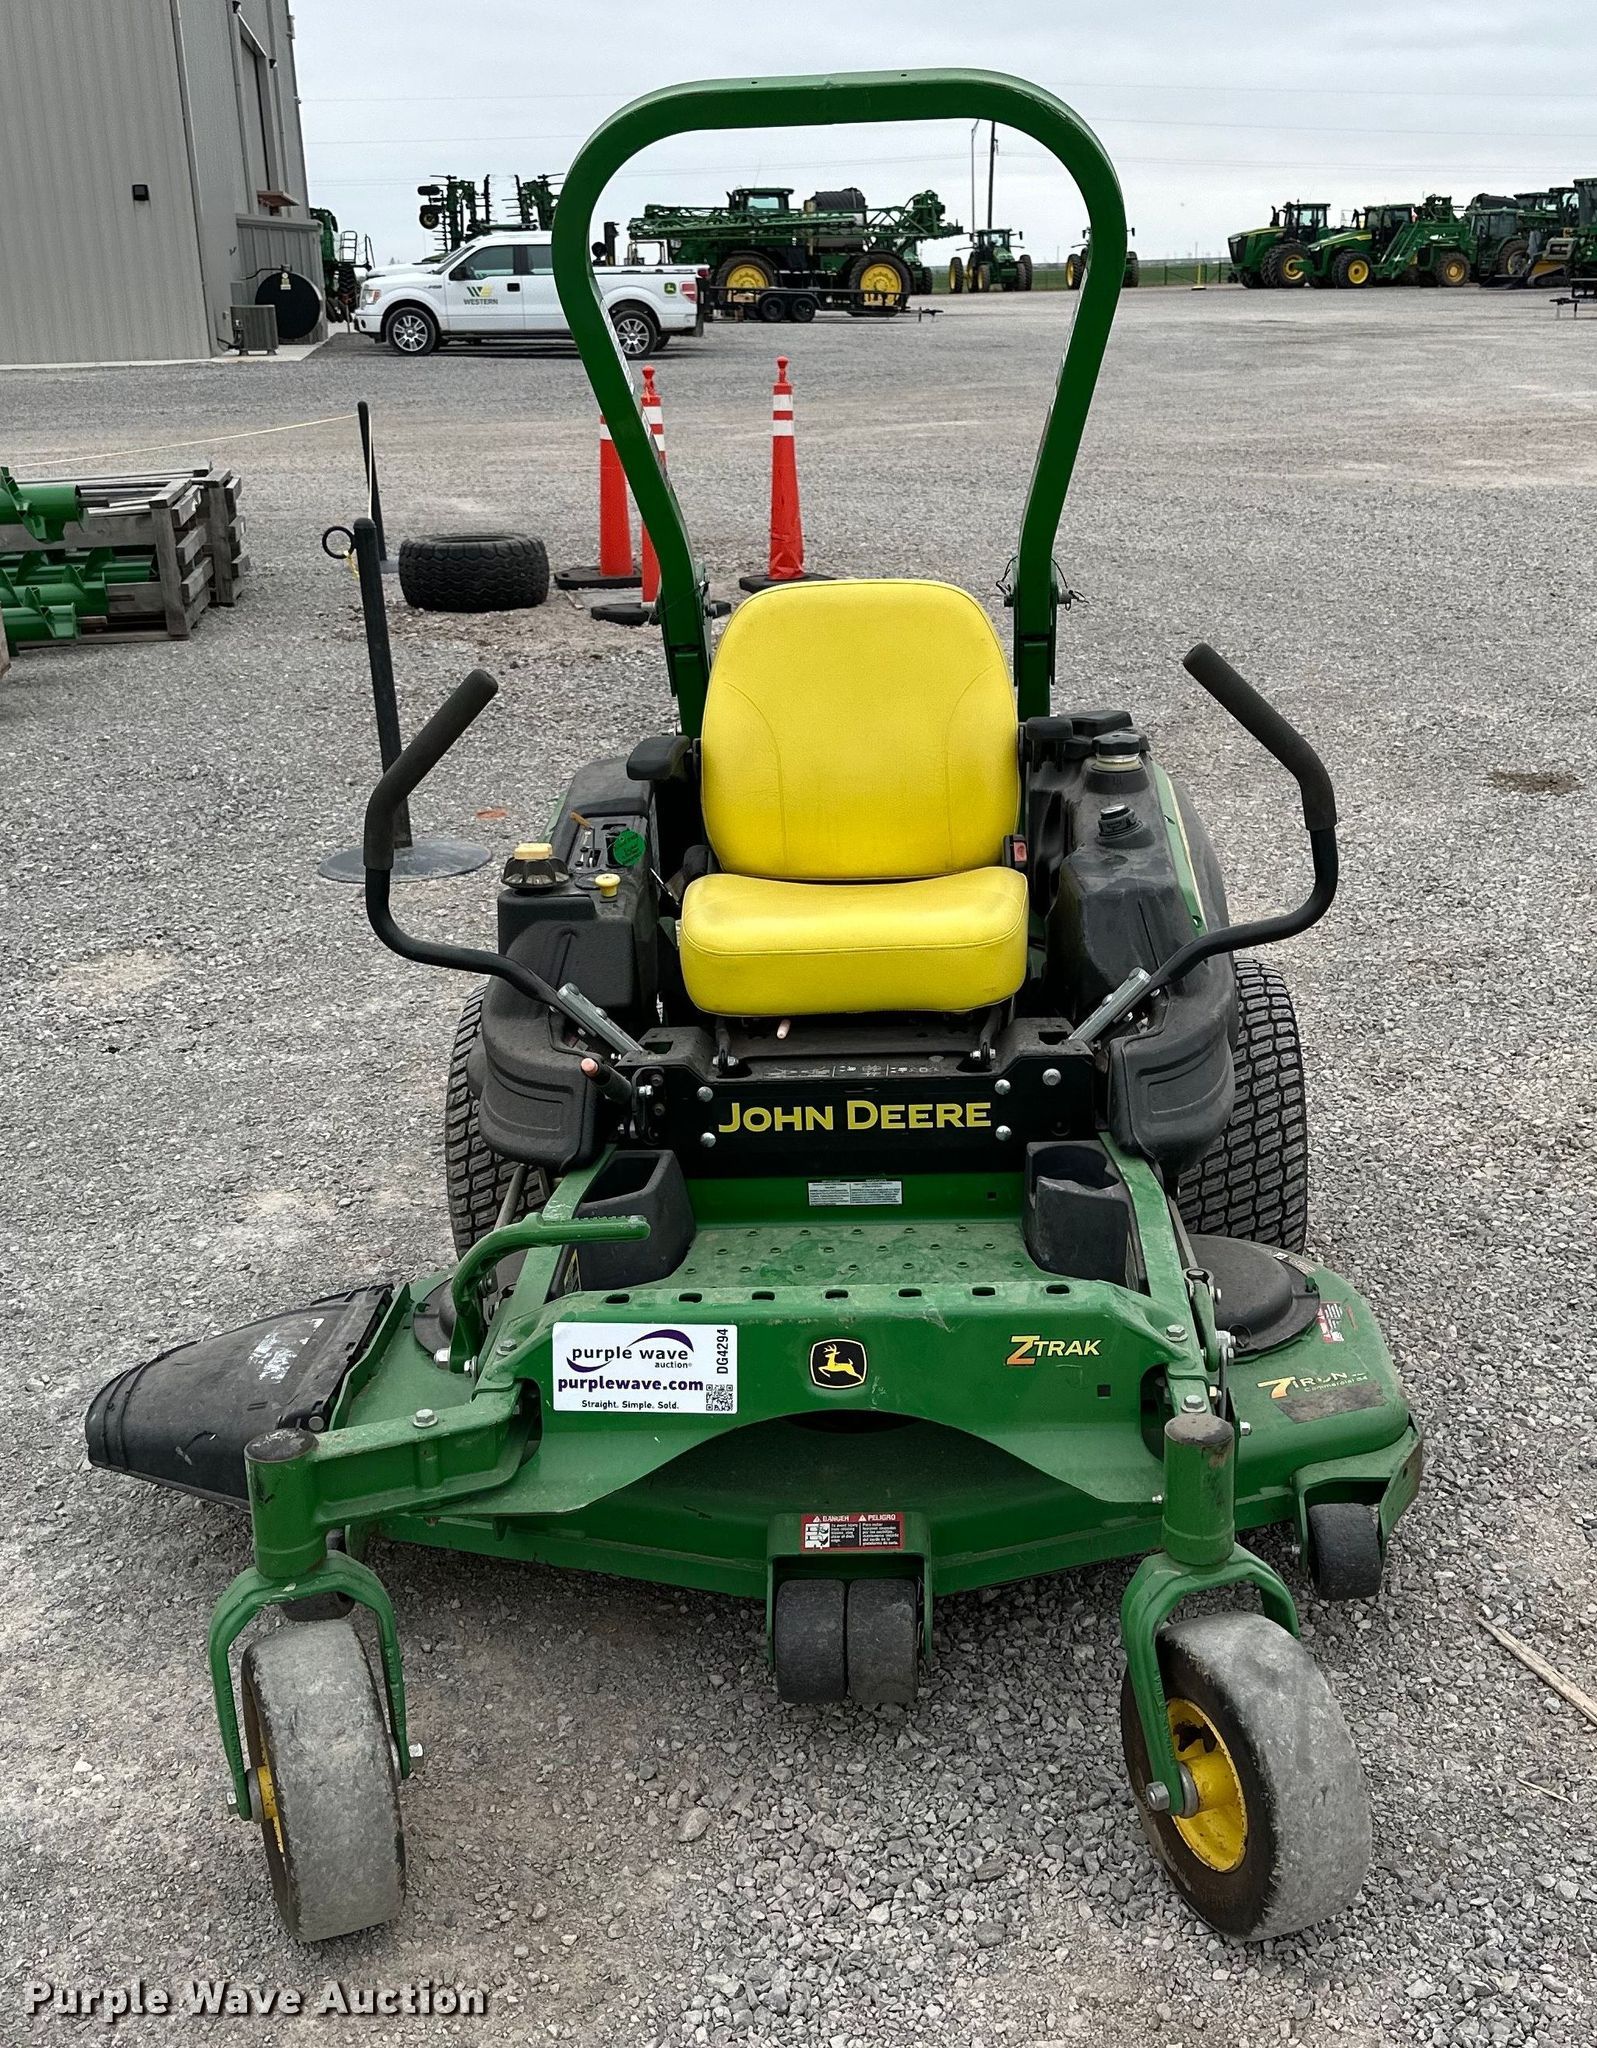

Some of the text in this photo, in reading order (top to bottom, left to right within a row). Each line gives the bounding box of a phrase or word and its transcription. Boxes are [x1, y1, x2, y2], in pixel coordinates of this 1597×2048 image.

[718, 1100, 992, 1133] JOHN DEERE
[572, 1346, 689, 1361] purple wave
[716, 1328, 729, 1374] DG4294
[558, 1375, 704, 1393] purplewave.com
[581, 1400, 680, 1410] Straight. Simple. Sold.
[867, 1513, 896, 1521] PELIGRO
